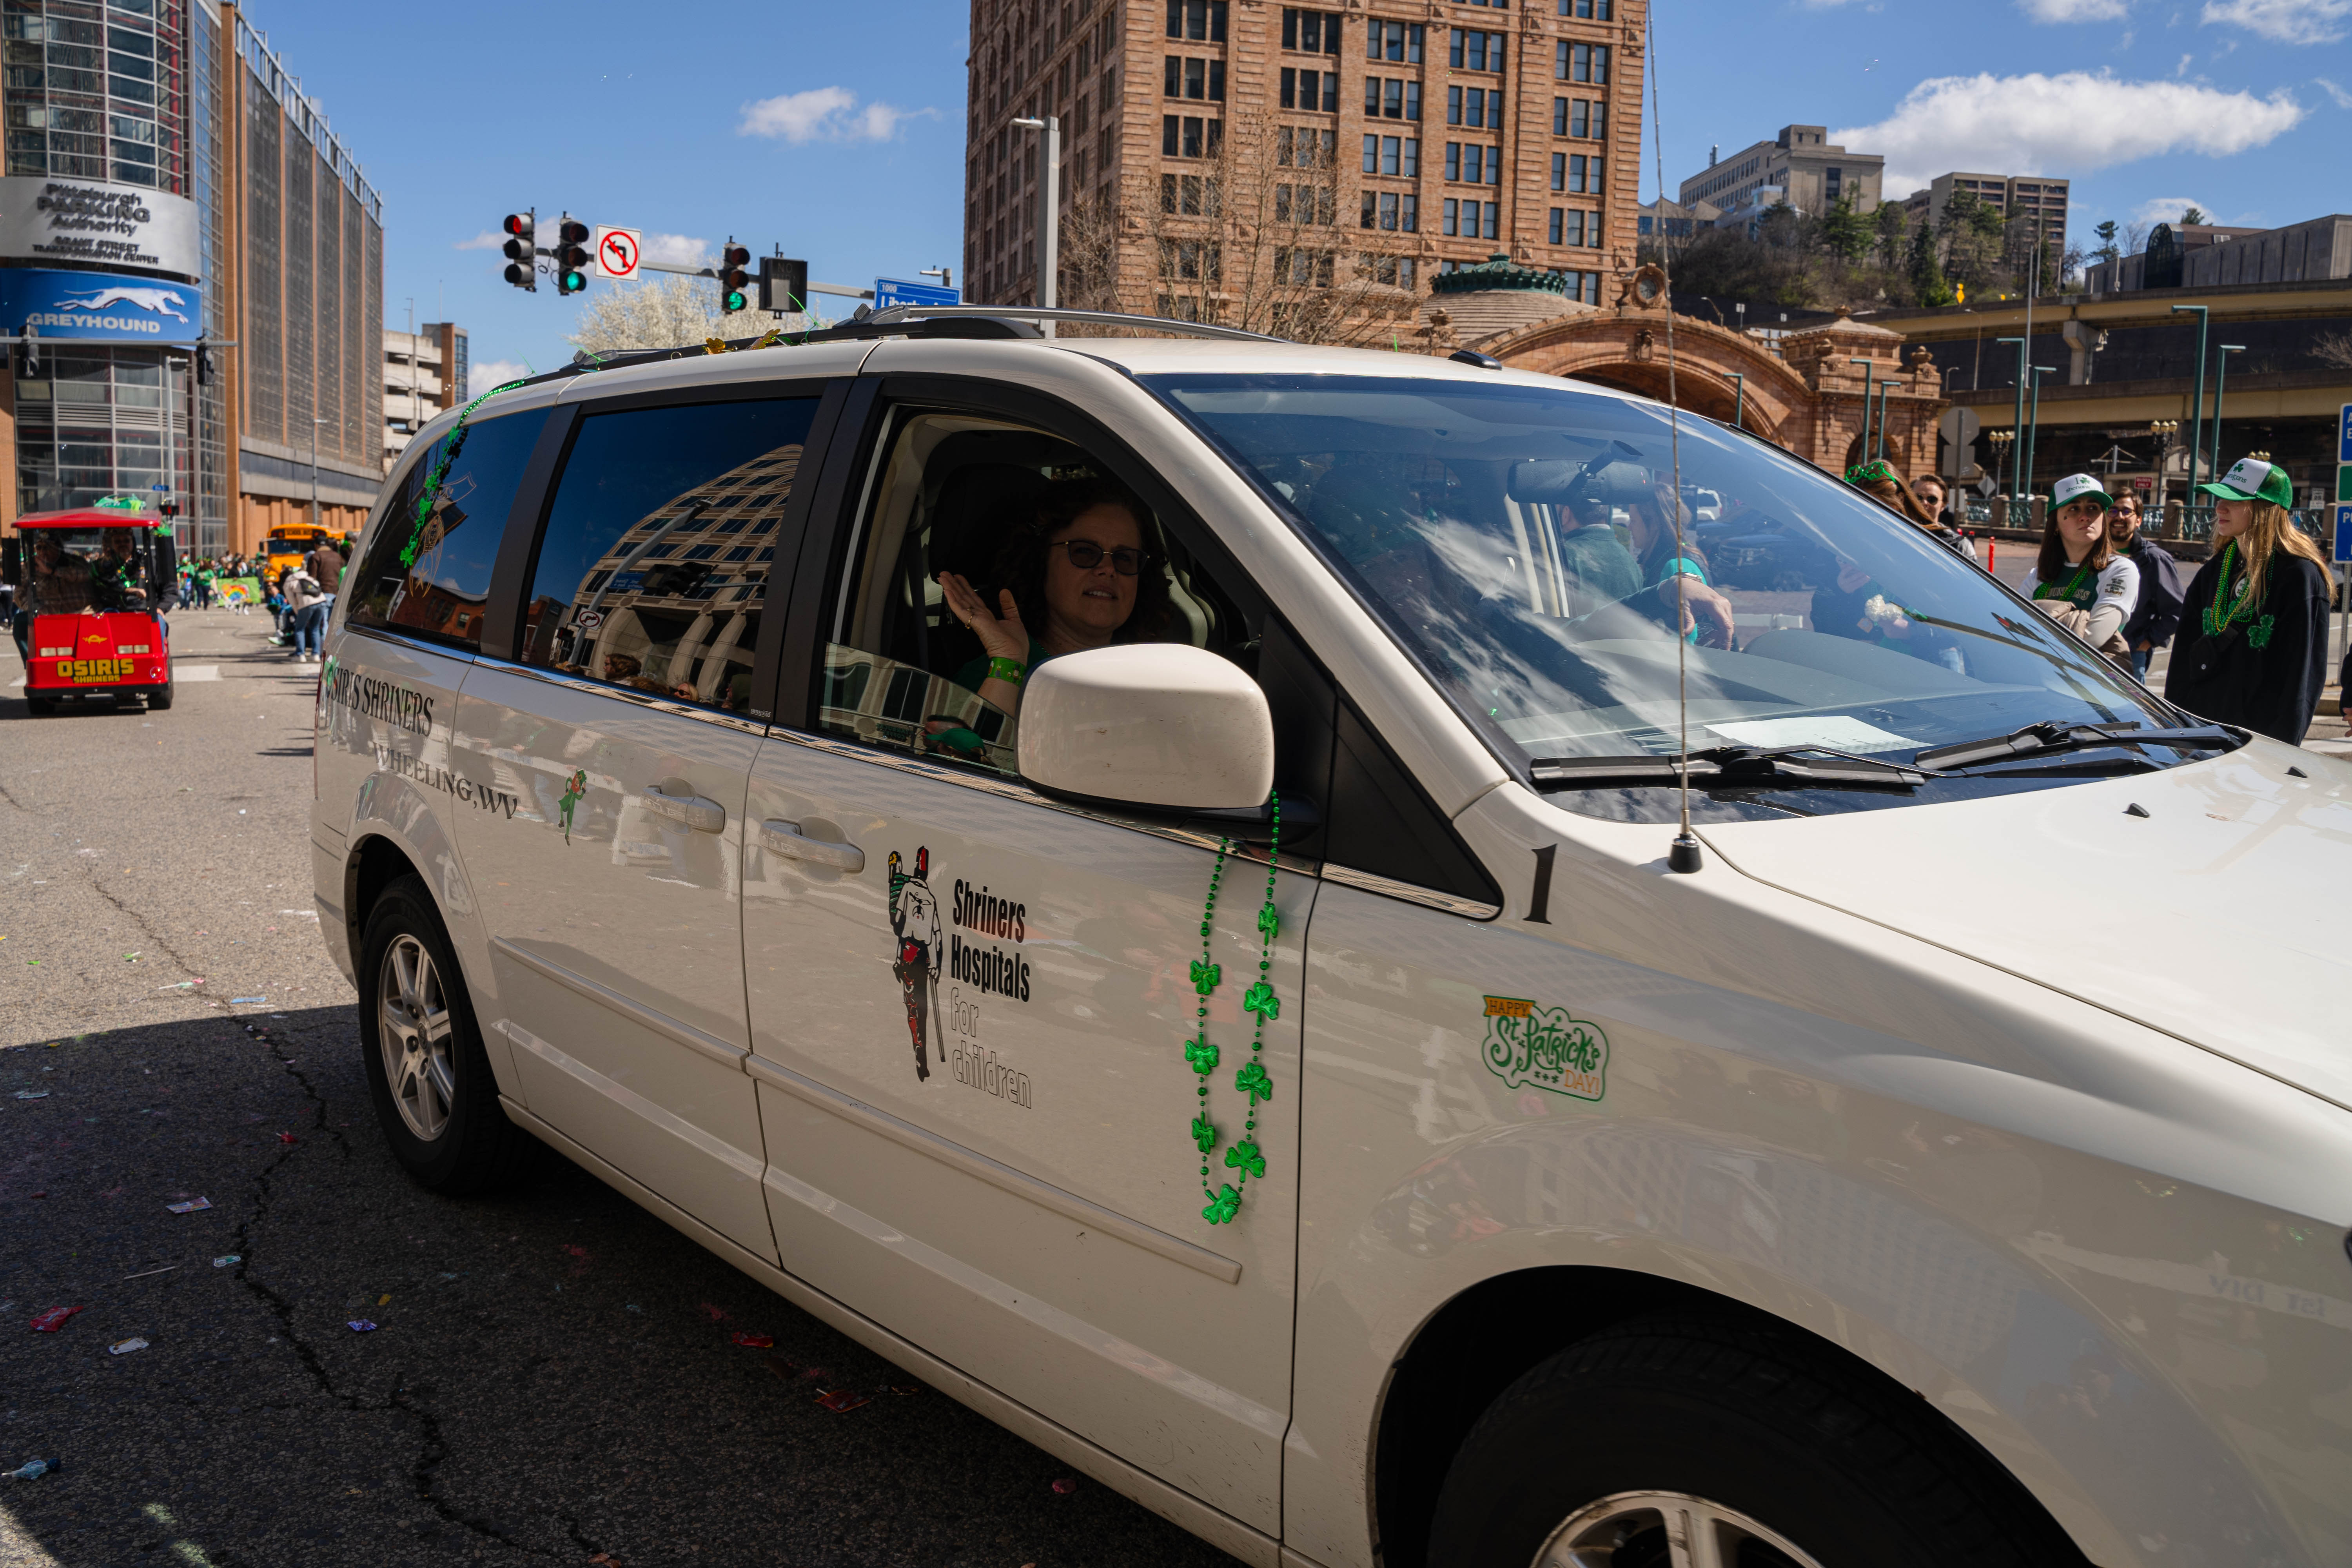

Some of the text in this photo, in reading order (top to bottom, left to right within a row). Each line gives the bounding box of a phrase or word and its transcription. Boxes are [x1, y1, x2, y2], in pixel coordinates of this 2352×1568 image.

[46, 183, 142, 207] Pittsburgh
[37, 196, 151, 223] PARKING
[52, 214, 137, 237] Authority
[55, 236, 140, 252] GRANT STREET
[124, 254, 159, 265] CENTER
[882, 284, 897, 292] 1000
[29, 313, 160, 333] GREYHOUND
[57, 658, 134, 677] OSIRIS
[73, 675, 120, 683] SHRINERS
[361, 677, 434, 737] SHRINERS
[1523, 843, 1558, 925] 1
[953, 878, 1026, 944] Shriners
[951, 934, 1030, 1002] Hospitals
[951, 987, 979, 1038] for
[1490, 1000, 1529, 1016] HAPPY
[952, 1040, 1032, 1109] children
[1564, 1069, 1600, 1095] DAY!
